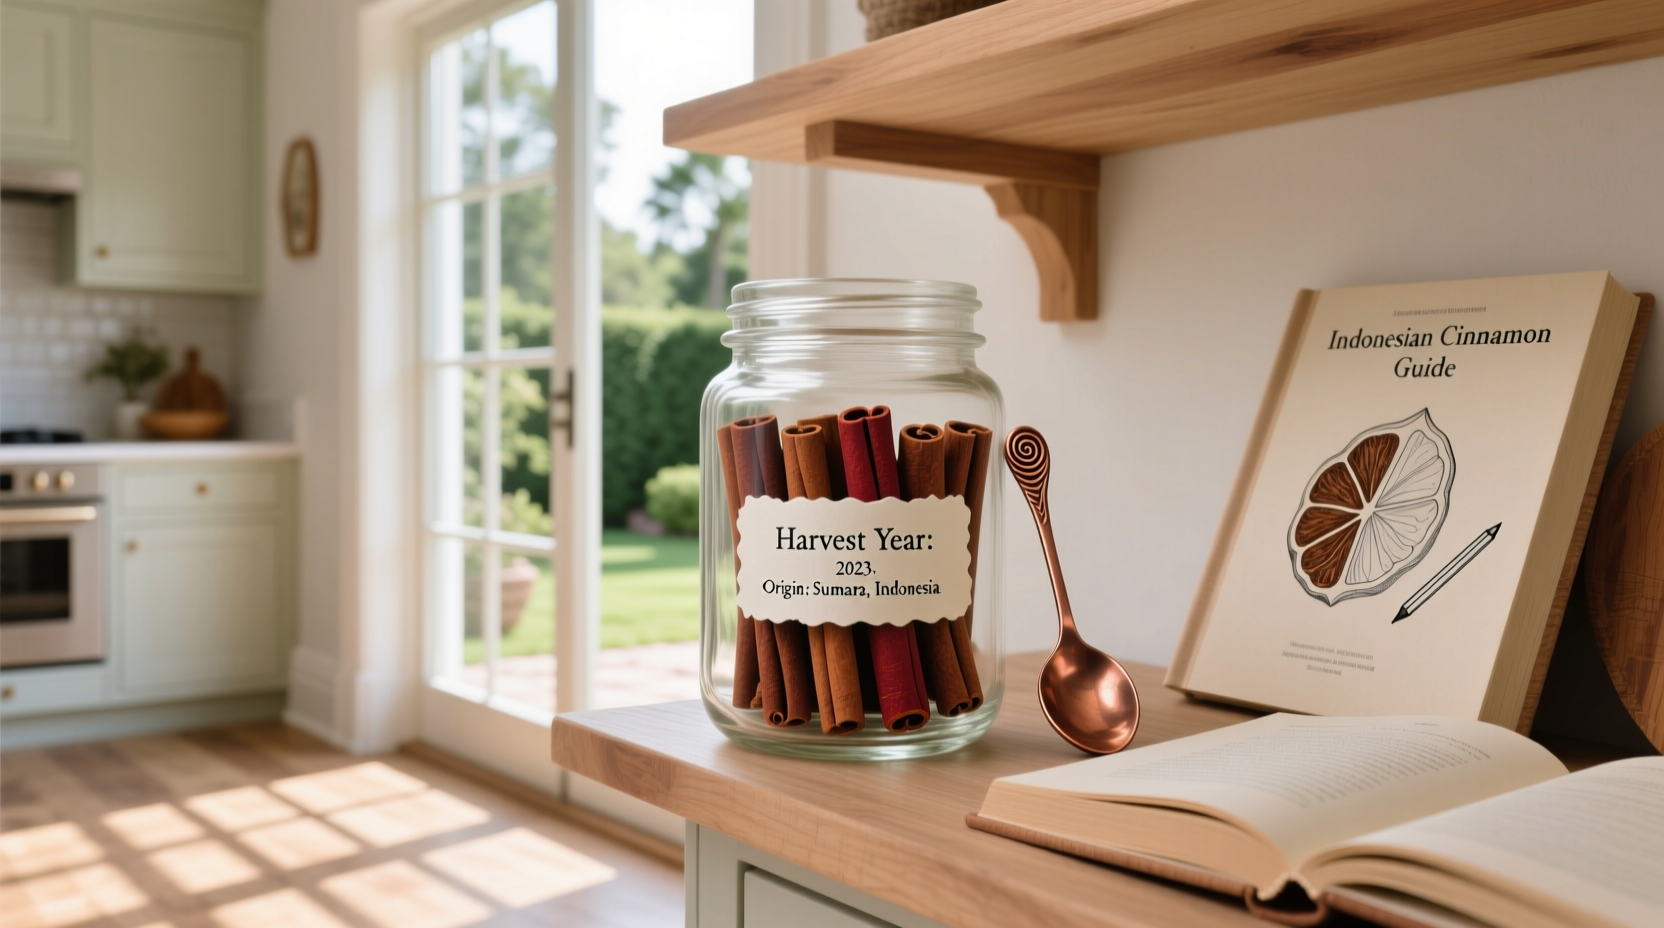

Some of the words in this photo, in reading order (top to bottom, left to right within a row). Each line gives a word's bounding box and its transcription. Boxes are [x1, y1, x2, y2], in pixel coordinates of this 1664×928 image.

[1327, 326, 1433, 350] Indonesian
[1440, 324, 1552, 347] Cinnamon
[1393, 355, 1457, 379] Guide
[775, 526, 867, 552] Harvest
[873, 527, 933, 551] Year:
[762, 578, 811, 600] Origin:
[874, 578, 942, 597] Indonesia
